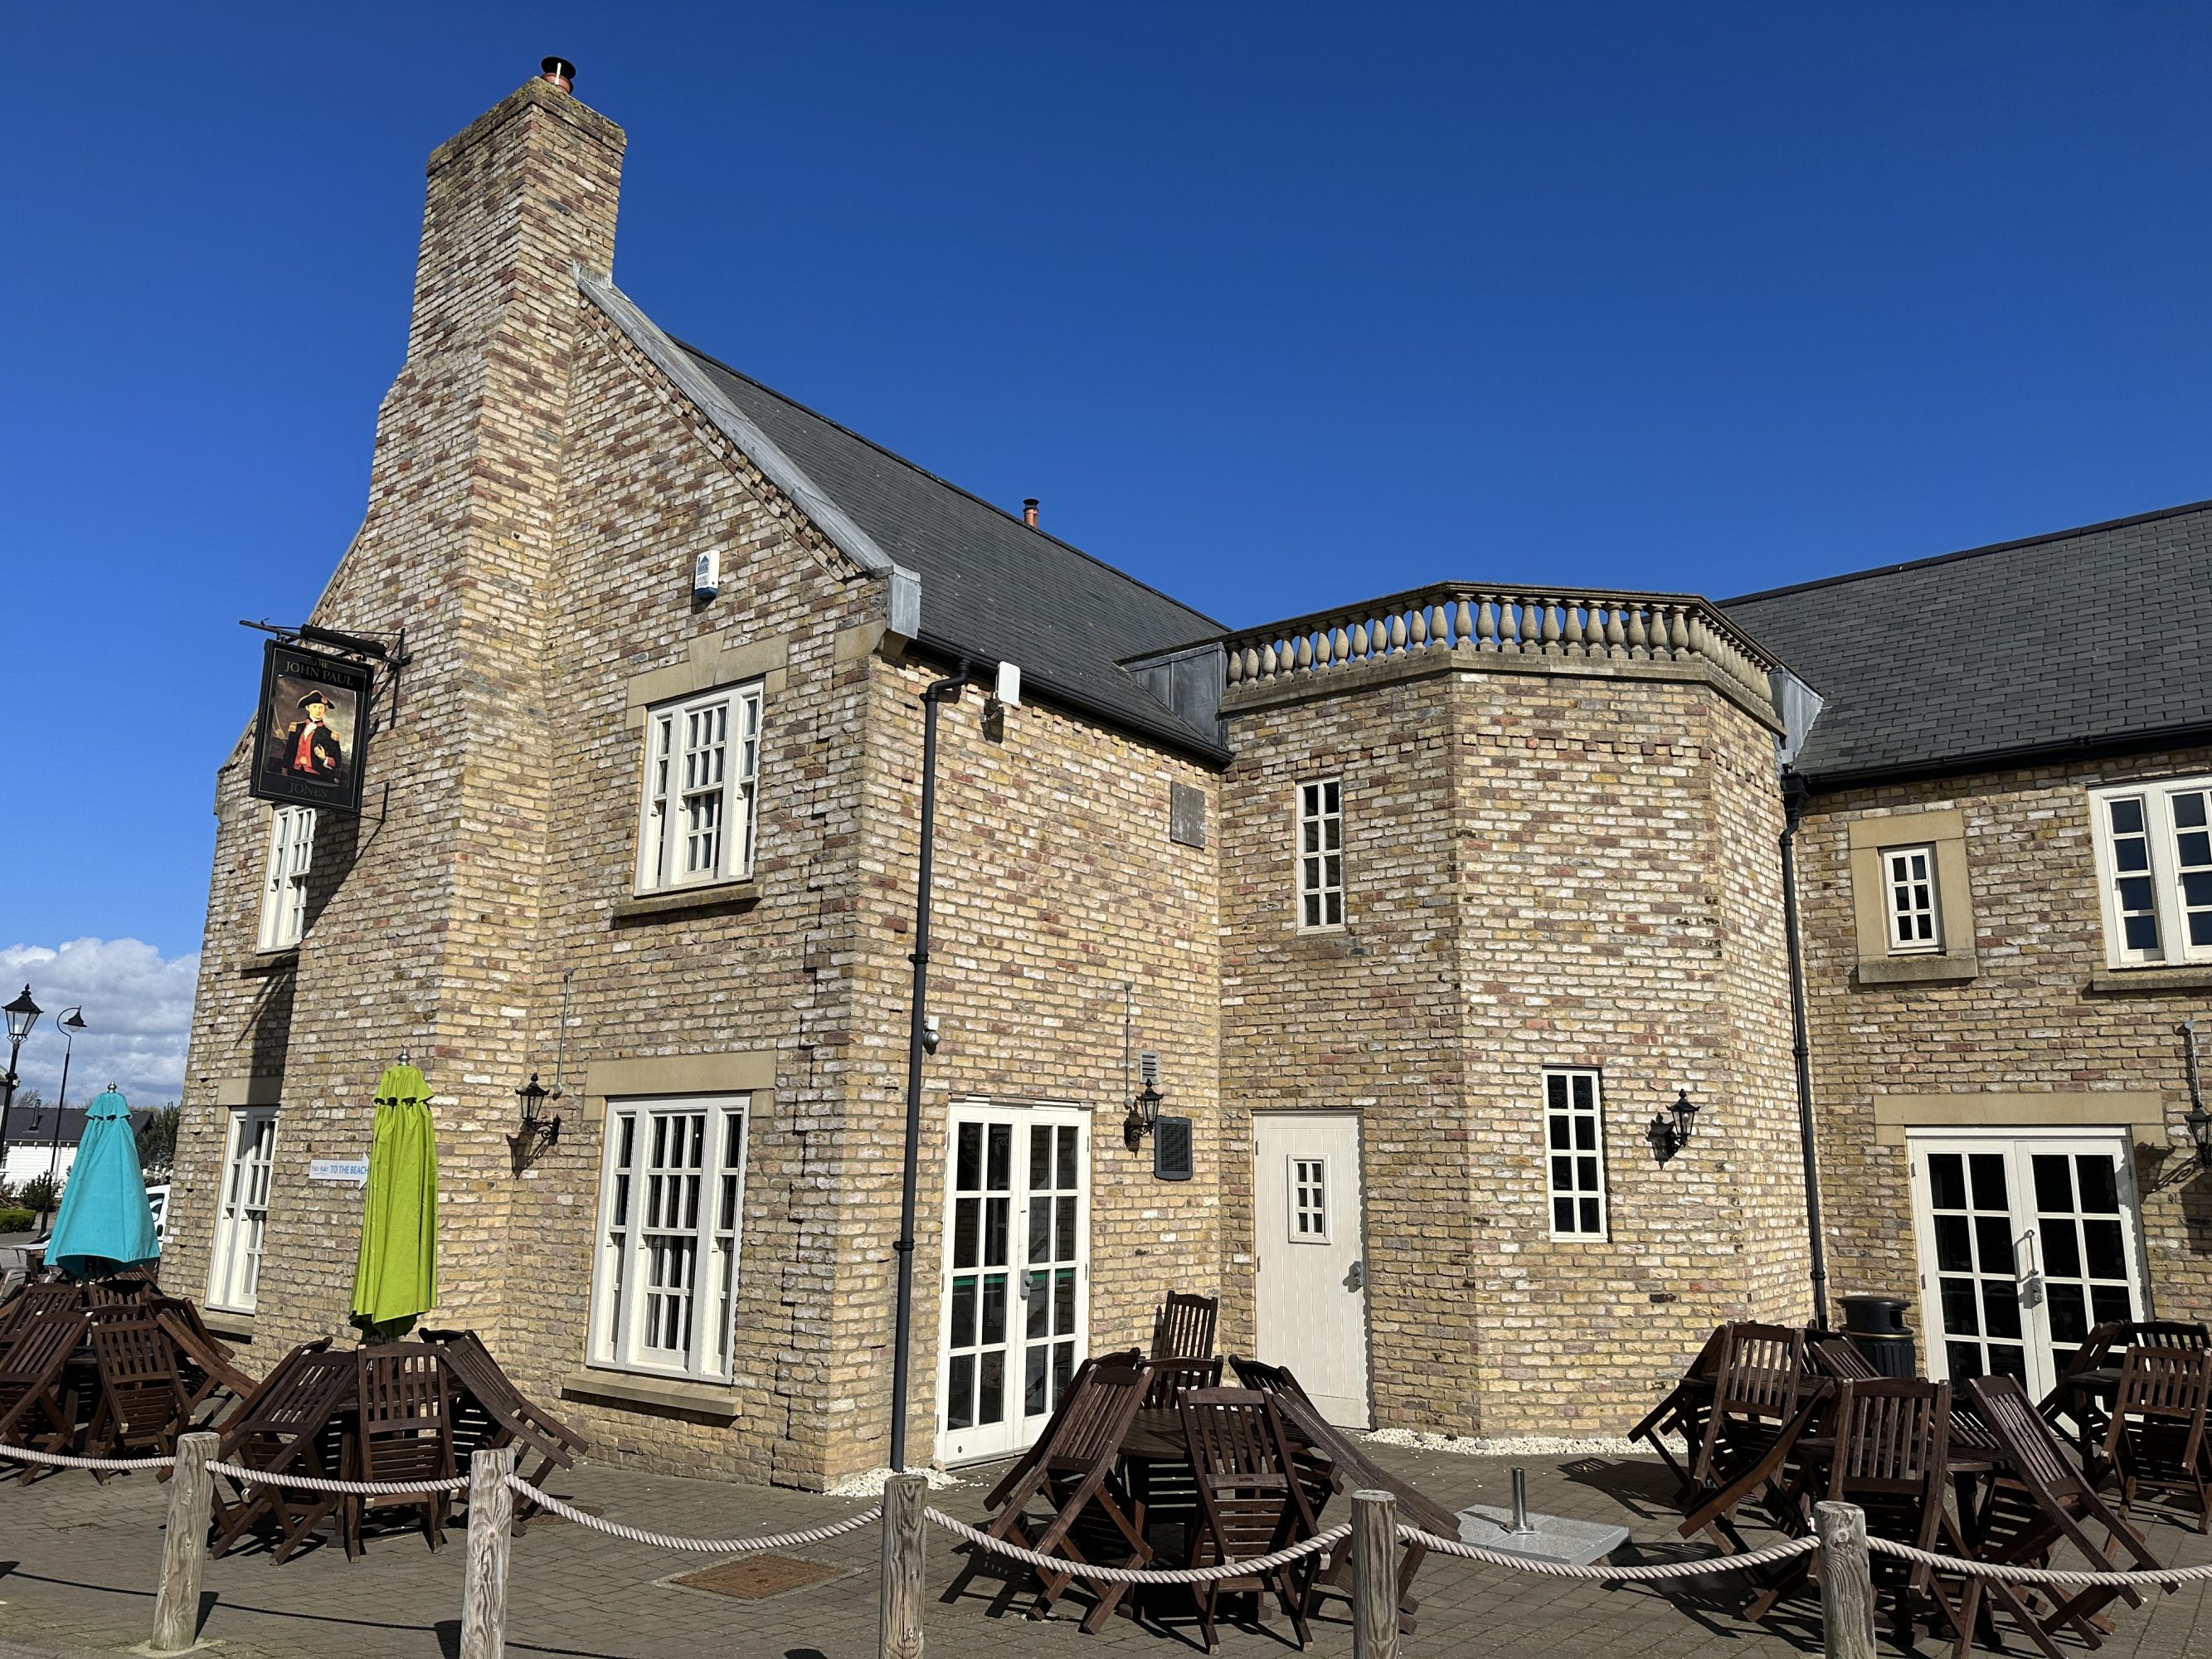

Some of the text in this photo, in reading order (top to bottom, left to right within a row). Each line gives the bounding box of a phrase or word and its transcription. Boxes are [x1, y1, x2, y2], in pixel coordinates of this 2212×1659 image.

[312, 659, 329, 669] THE
[284, 661, 354, 686] JOHN PAUL
[288, 782, 327, 797] JONES
[330, 1165, 338, 1174] TO
[338, 1165, 349, 1175] THE
[349, 1165, 369, 1175] BEACH
